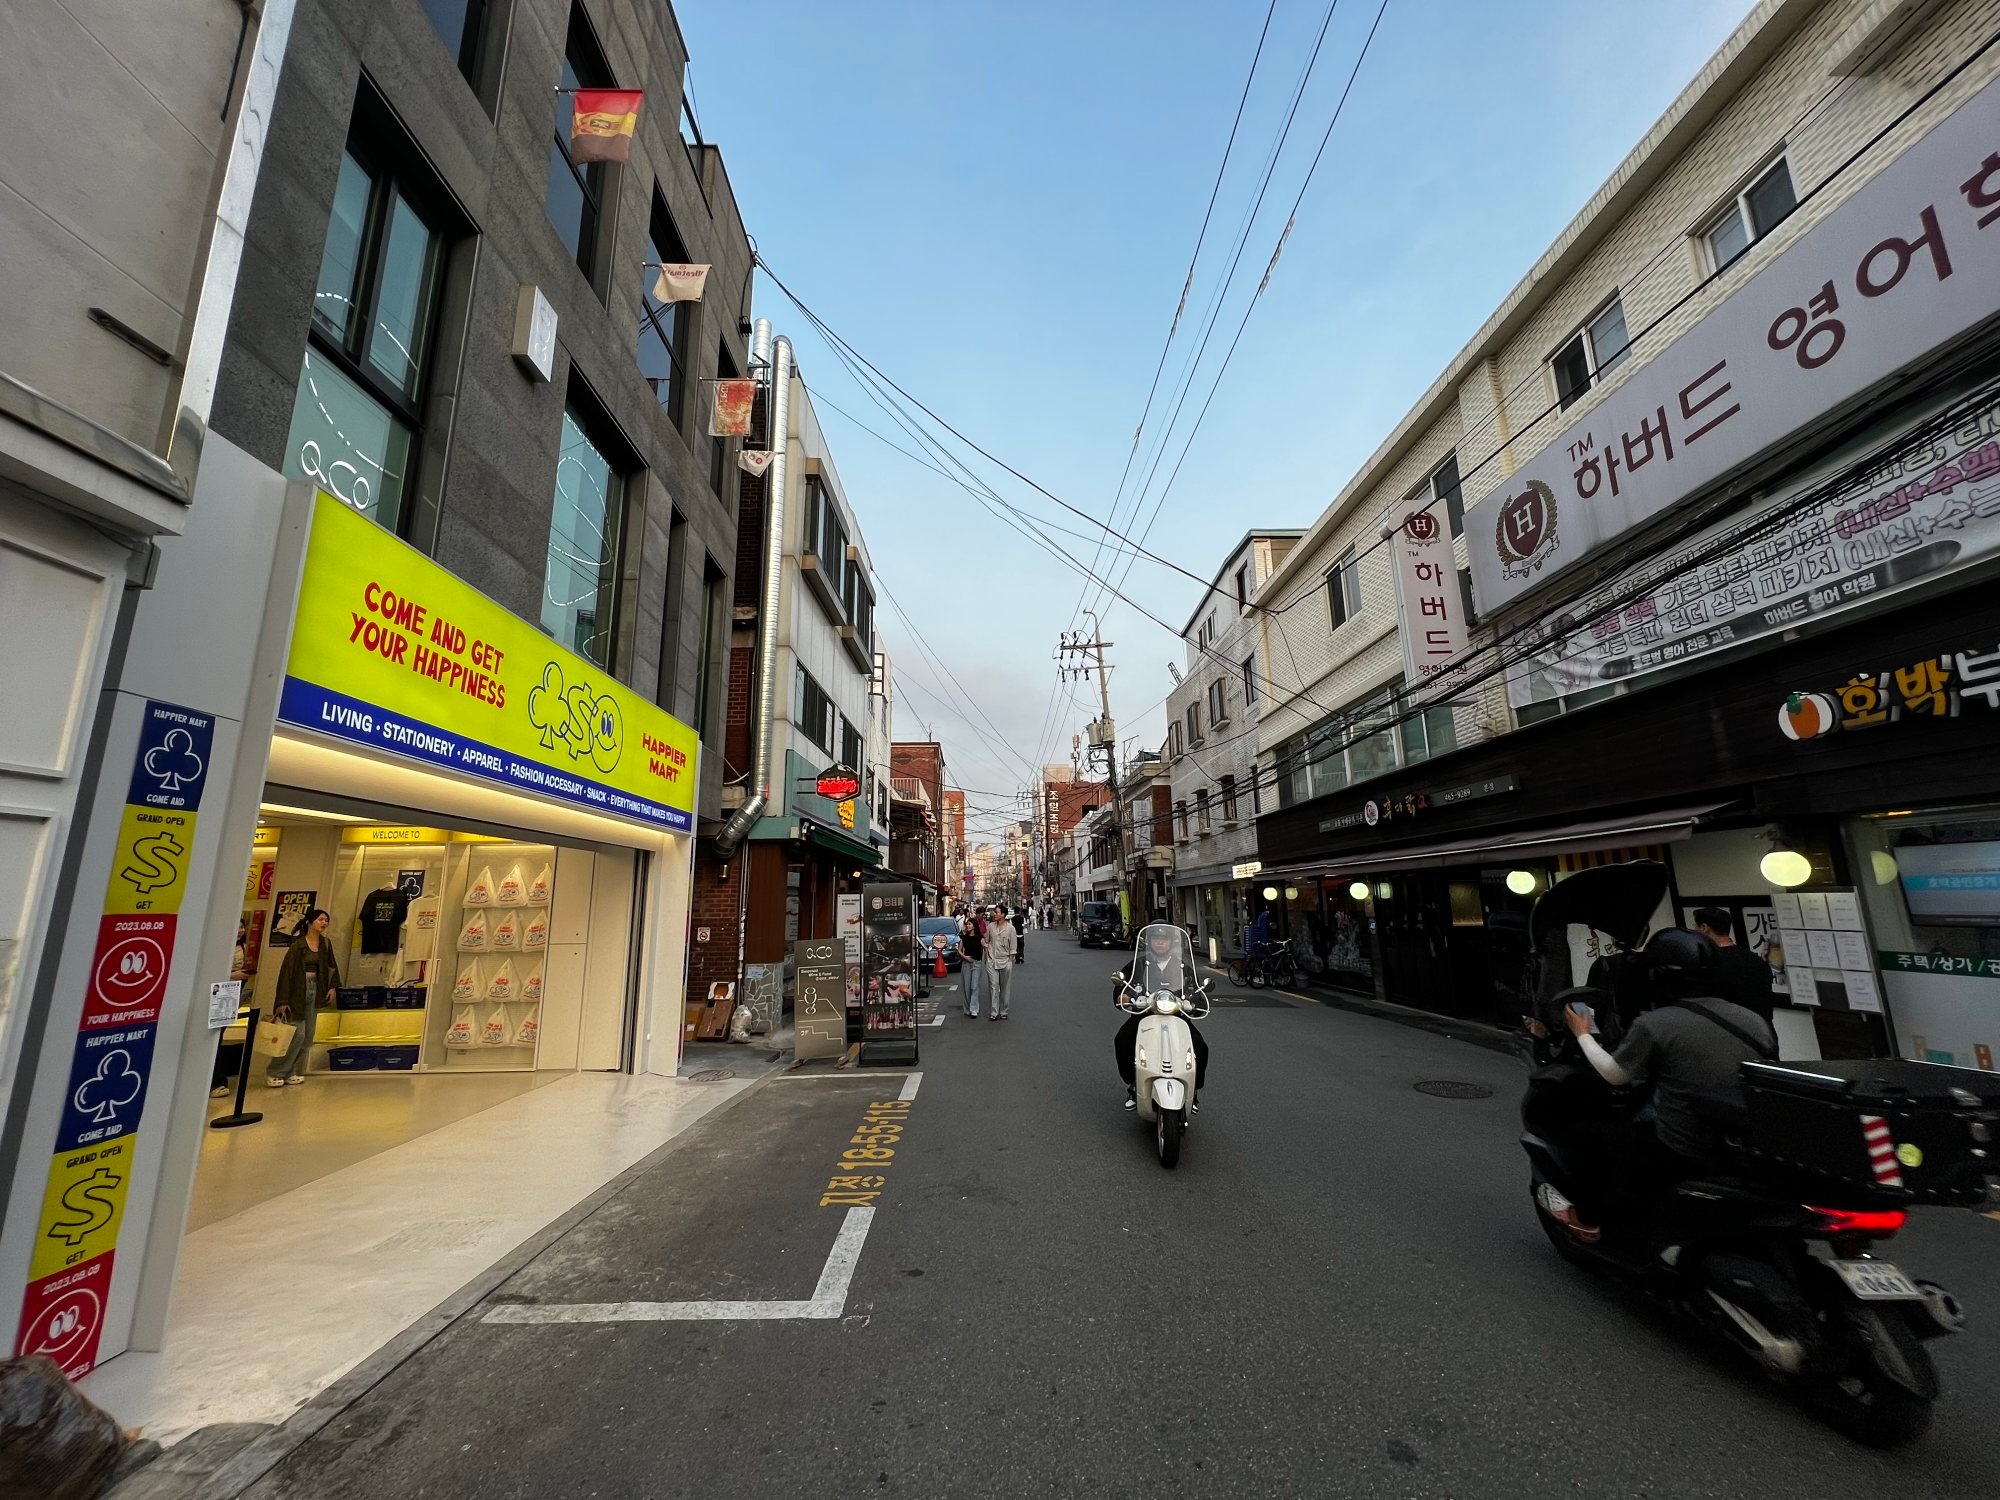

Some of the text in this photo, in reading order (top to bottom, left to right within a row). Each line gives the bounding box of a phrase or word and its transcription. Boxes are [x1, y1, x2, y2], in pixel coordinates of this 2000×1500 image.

[1573, 378, 1741, 499] 하버드
[1767, 205, 1953, 369] 영어
[1566, 431, 1594, 462] TM
[1711, 579, 1758, 617] 실력
[1761, 547, 1840, 599] 패키지
[1414, 562, 1453, 654] 하버드
[1764, 599, 1808, 625] 하버드
[1808, 587, 1841, 610] 영어
[364, 582, 504, 675] COME AND GET
[349, 612, 506, 709] YOUR HAPPINESS
[154, 709, 208, 728] HAPPIER MART
[322, 702, 373, 733] LIVING
[383, 722, 455, 758] STATIONERY
[462, 748, 503, 772] APPAREL
[510, 763, 544, 785] FASHION
[545, 776, 583, 796] ACCESSARY
[587, 789, 606, 803] SNACK
[642, 733, 687, 768] HAPPIER
[649, 758, 679, 783] MART
[147, 794, 184, 806] COME AND
[137, 813, 186, 826] GRAND OPEN
[372, 831, 420, 839] WELCOME TO
[136, 901, 153, 910] GET
[283, 893, 310, 904] OPEN
[87, 1008, 154, 1025] YOUR HAPPINESS
[86, 1029, 149, 1047] HAPPIER MART
[78, 1124, 123, 1143] COME AND
[66, 1145, 123, 1168] GRAND OPEN
[65, 1250, 86, 1265] GET
